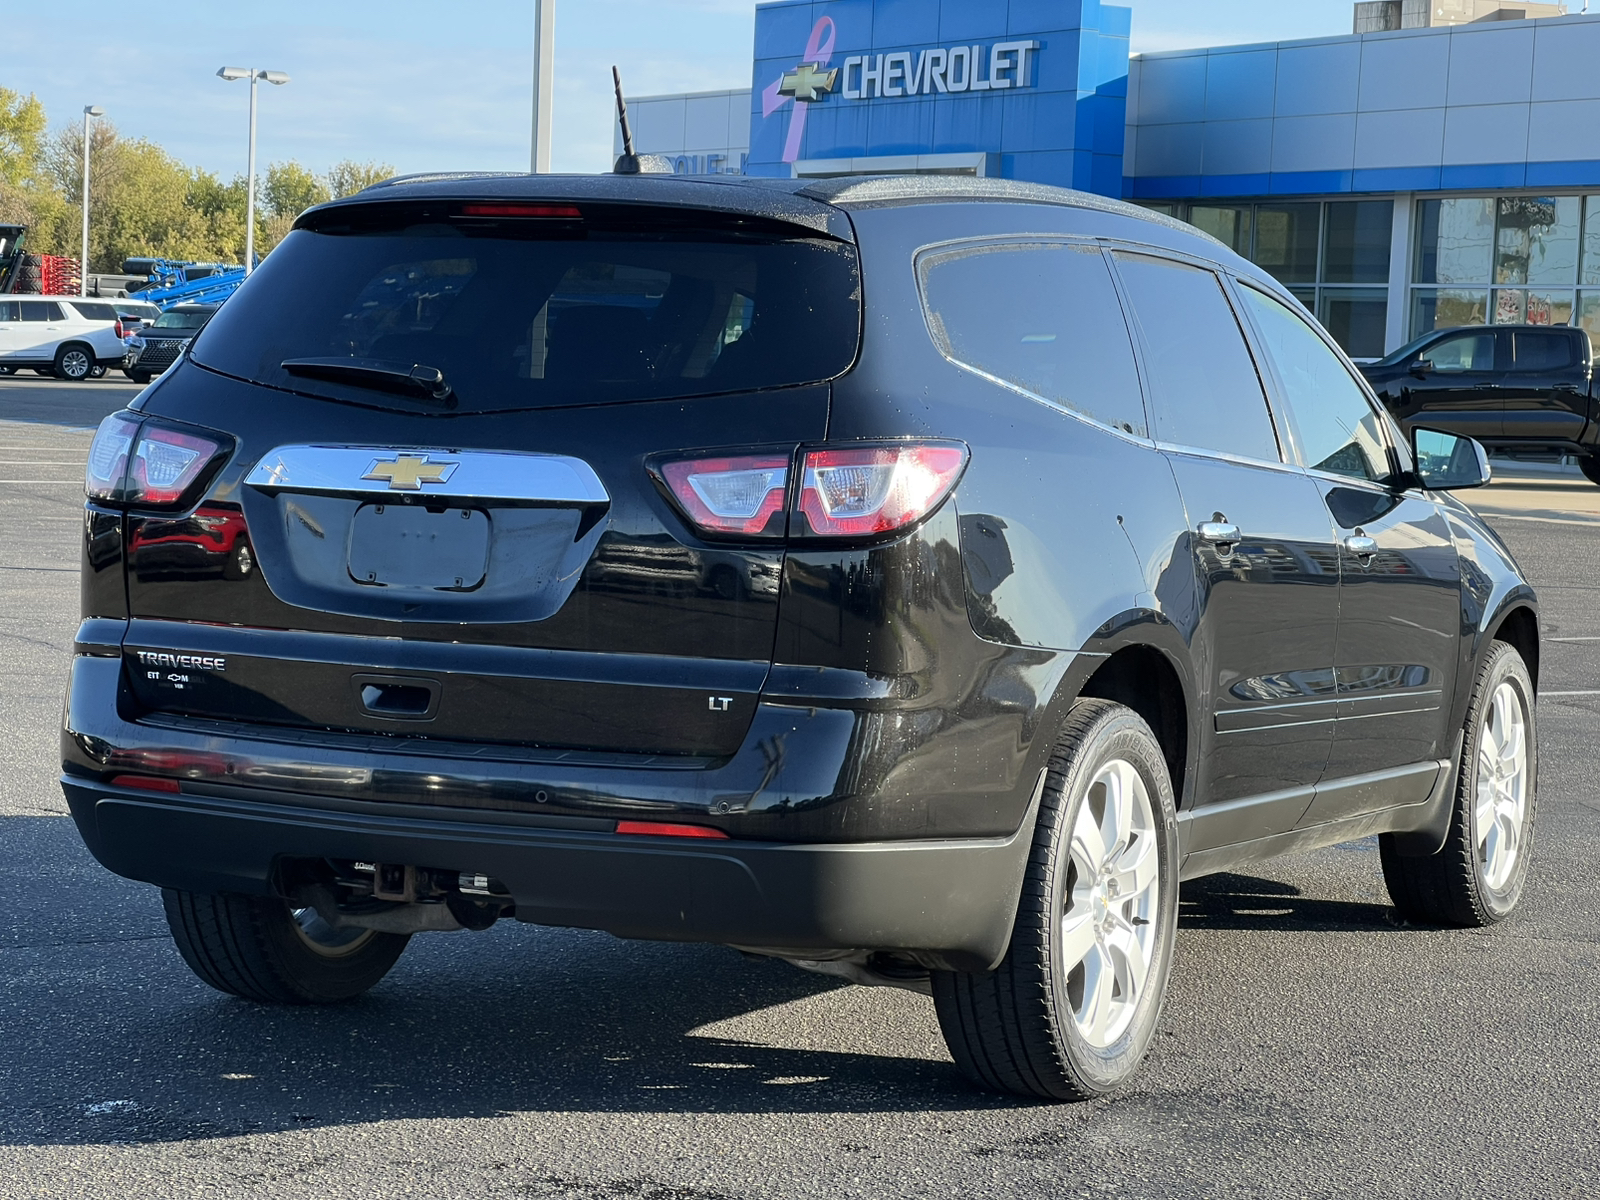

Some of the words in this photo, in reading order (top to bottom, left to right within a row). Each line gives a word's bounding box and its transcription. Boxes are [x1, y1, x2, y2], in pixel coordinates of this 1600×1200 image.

[842, 40, 1038, 99] CHEVROLET
[137, 651, 225, 671] TRAVERSE
[708, 696, 734, 711] LT
